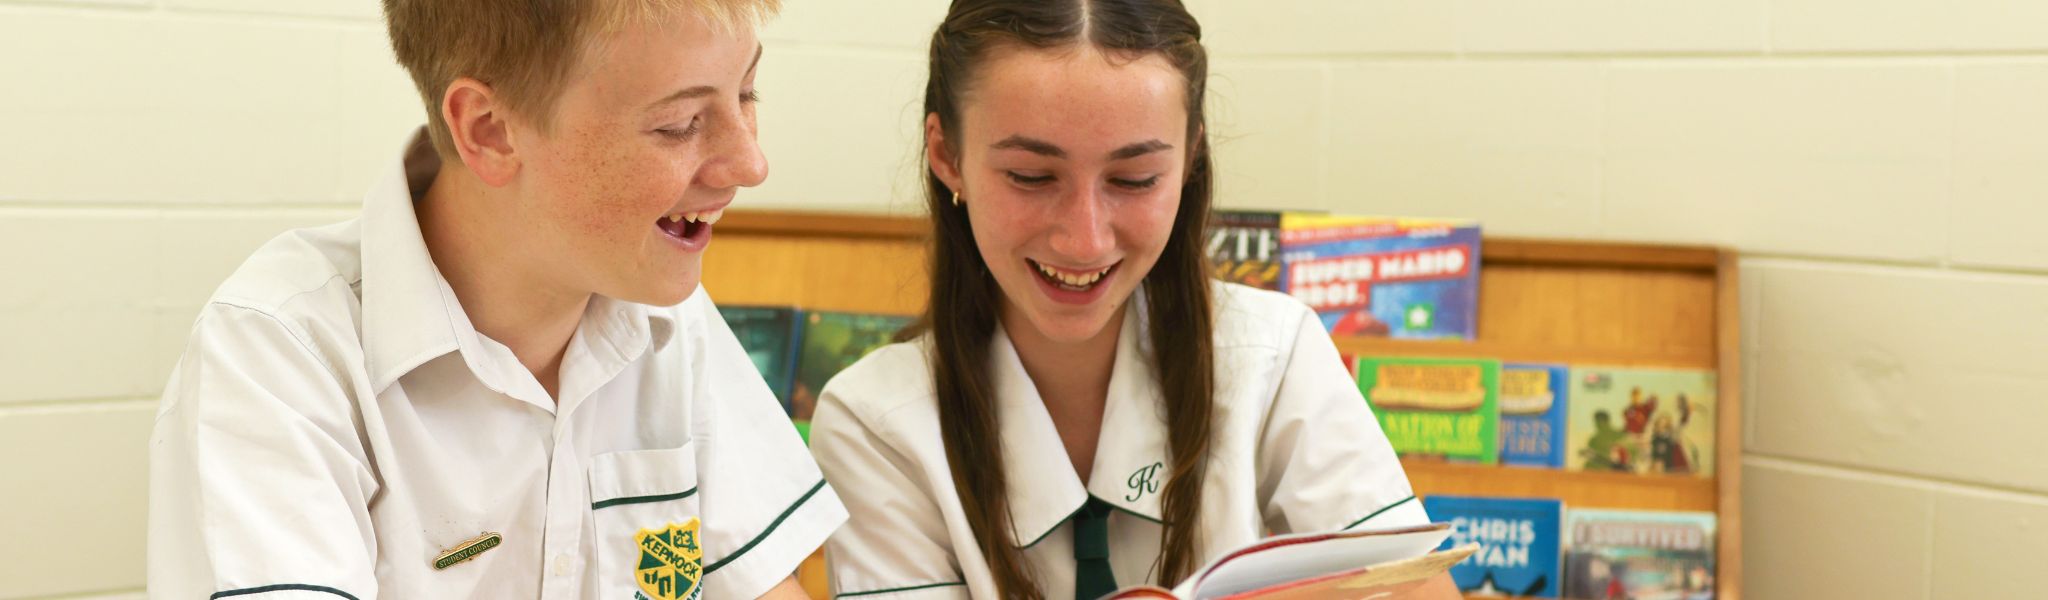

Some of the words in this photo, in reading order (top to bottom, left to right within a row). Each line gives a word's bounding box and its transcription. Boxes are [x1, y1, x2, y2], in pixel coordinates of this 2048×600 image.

[1293, 258, 1373, 285] SUPER
[1378, 249, 1464, 277] MARIO
[1125, 462, 1163, 502] K
[1453, 517, 1535, 545] CHRIS
[439, 550, 468, 568] STUDENT
[468, 538, 497, 555] COUNCIL
[641, 534, 699, 579] KEPNOCK
